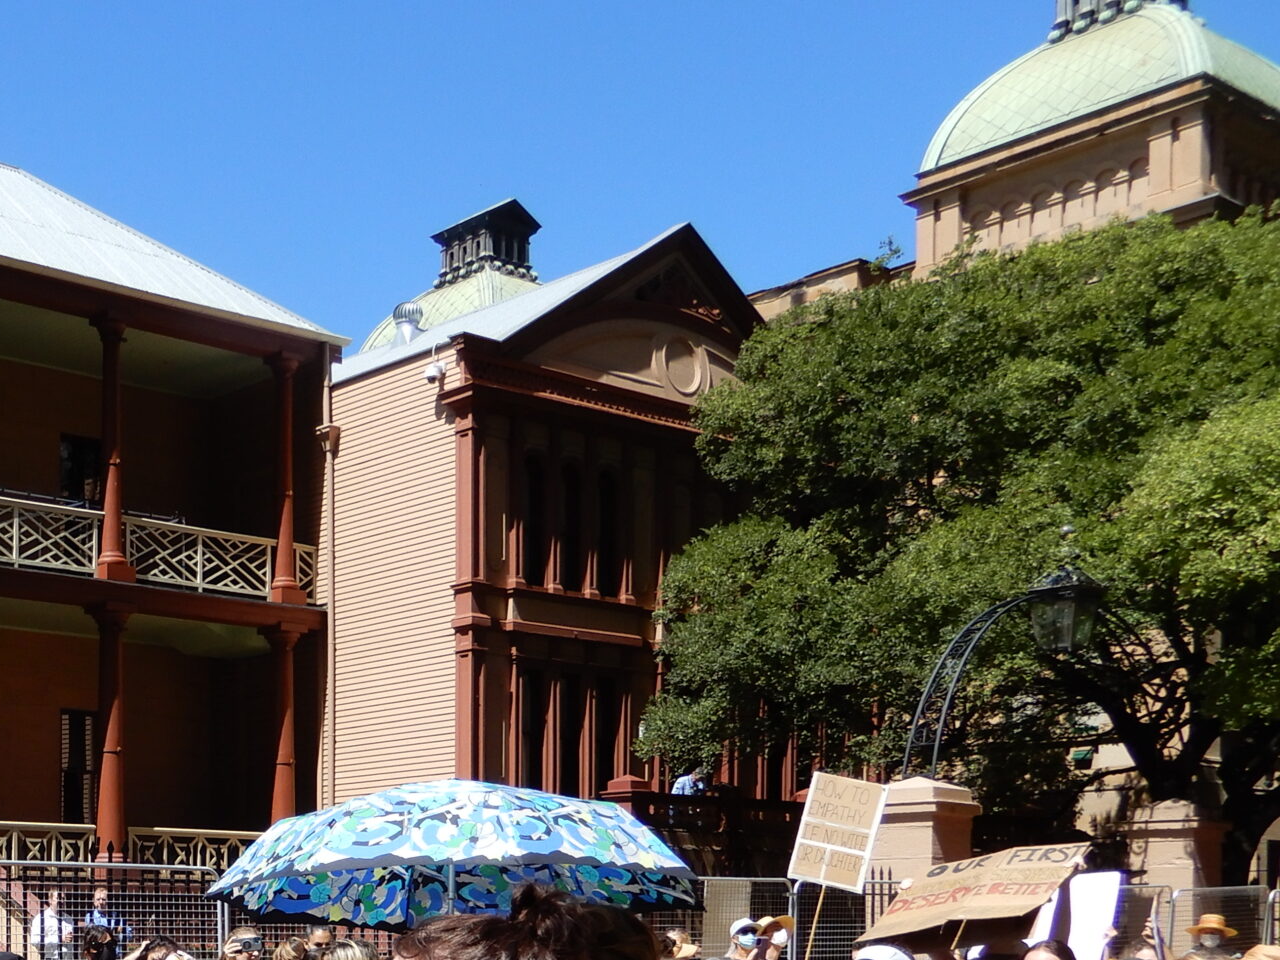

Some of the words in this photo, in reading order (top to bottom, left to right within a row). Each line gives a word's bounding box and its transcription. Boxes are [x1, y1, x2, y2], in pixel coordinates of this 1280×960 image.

[852, 786, 871, 806] TO
[808, 799, 867, 825] EMPATHY
[823, 828, 839, 846] NO
[841, 831, 869, 852] WIFE
[926, 855, 993, 878] OUR
[886, 884, 986, 916] DESERVE
[985, 881, 1059, 896] BETTER
